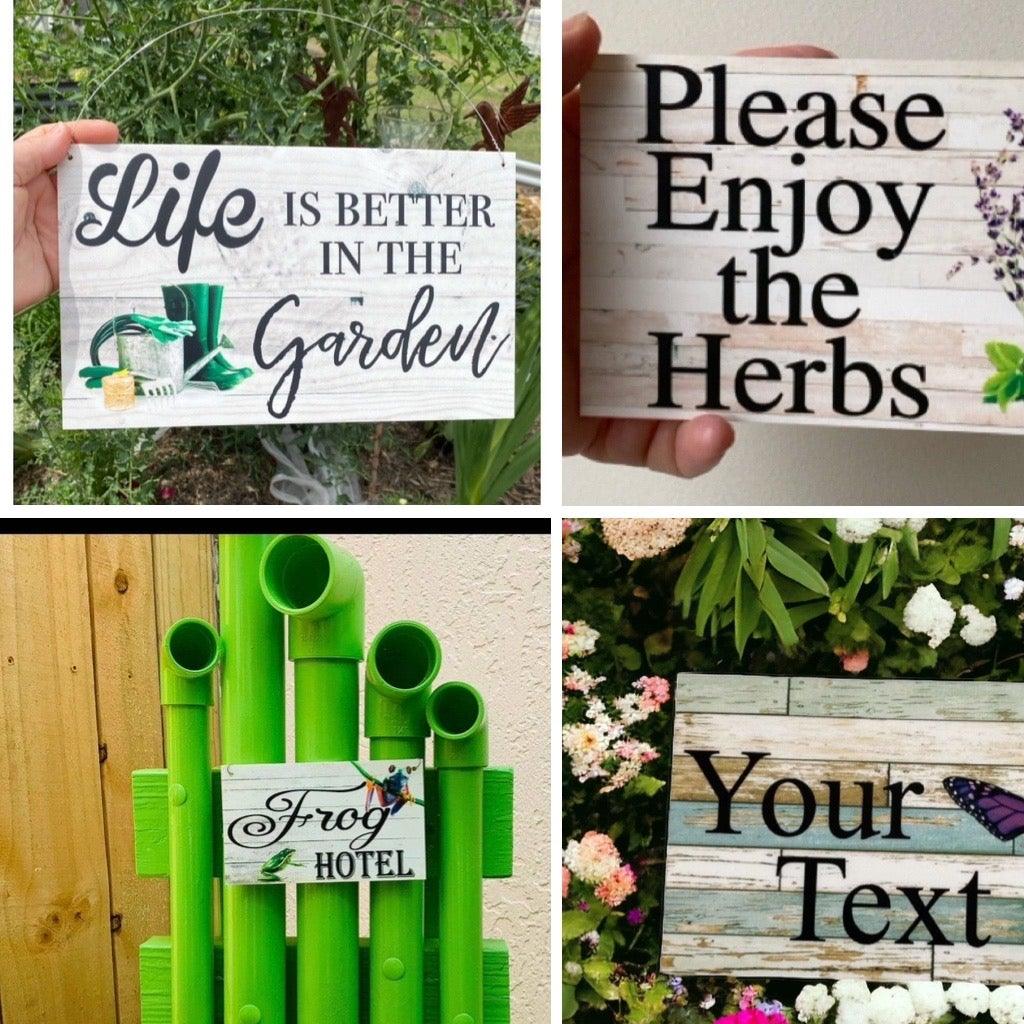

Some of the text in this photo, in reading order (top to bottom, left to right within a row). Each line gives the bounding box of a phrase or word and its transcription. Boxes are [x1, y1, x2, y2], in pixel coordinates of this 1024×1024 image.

[637, 64, 946, 151] Please
[75, 149, 263, 273] Life
[283, 191, 495, 228] IS BETTER
[647, 151, 934, 260] Enjoy
[320, 241, 462, 275] IN THE
[717, 246, 861, 328] the
[253, 285, 511, 419] Garden
[647, 331, 930, 419] Herbs
[228, 781, 391, 850] Frog
[684, 749, 925, 840] Your
[315, 850, 415, 880] HOTEL
[776, 856, 992, 948] Text
